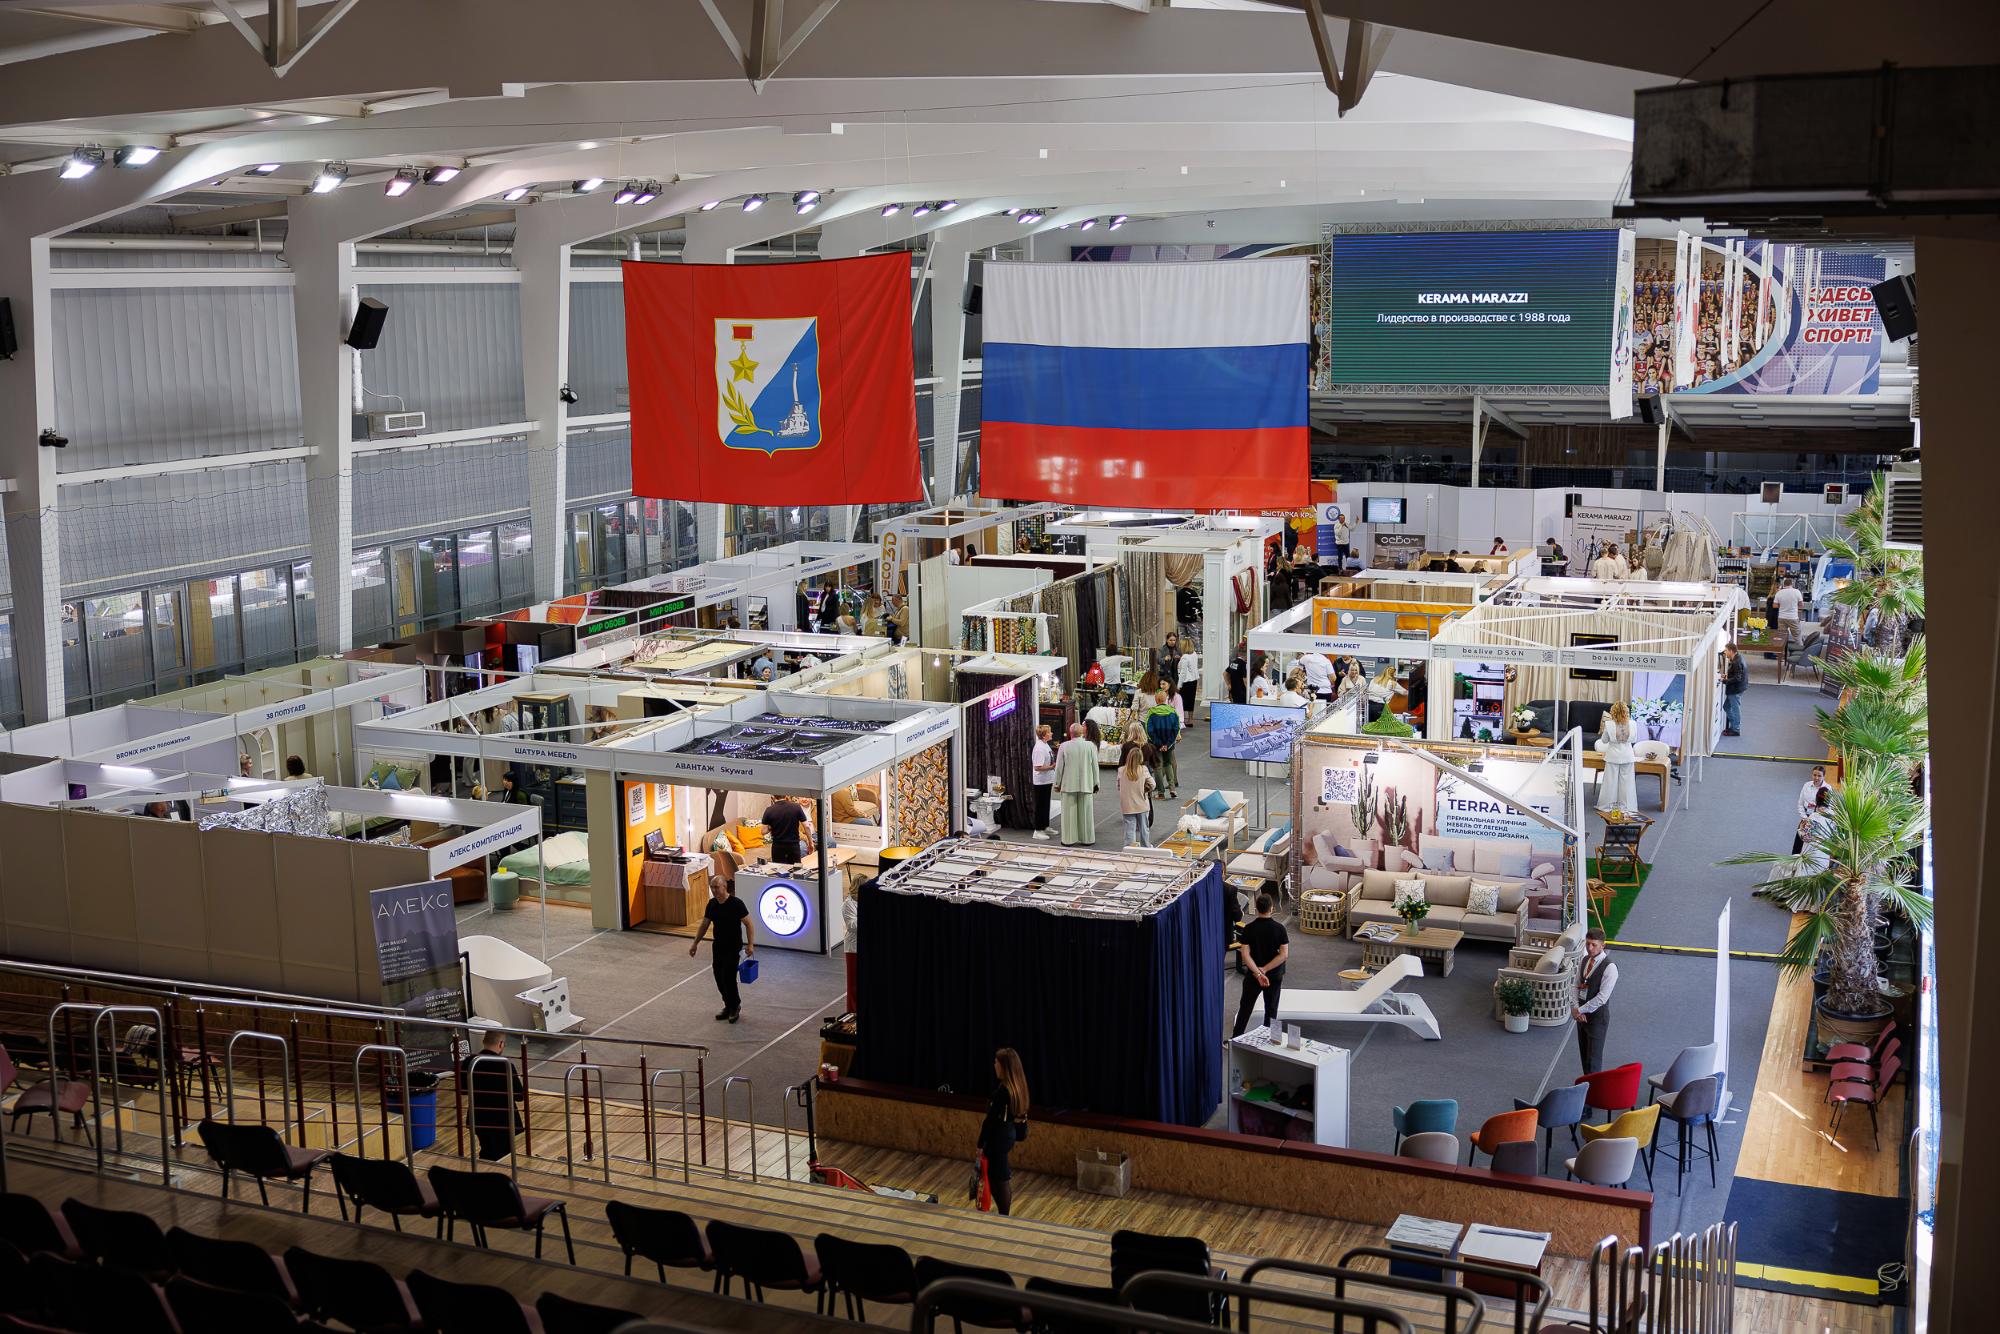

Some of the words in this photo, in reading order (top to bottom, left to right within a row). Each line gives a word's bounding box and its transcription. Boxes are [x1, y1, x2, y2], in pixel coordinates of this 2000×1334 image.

[1418, 293, 1470, 304] KERAMA
[1472, 292, 1528, 304] MARAZZI
[1809, 287, 1872, 304] ЗДЕСЬ
[1376, 313, 1428, 324] Лидерство
[1440, 314, 1508, 324] производстве
[1519, 313, 1545, 322] 1988
[1548, 314, 1571, 322] года
[1808, 308, 1874, 322] ЖИВЕТ
[1804, 328, 1872, 342] СПОРТ!
[650, 605, 664, 616] МИР
[664, 600, 685, 614] ОБОЕВ
[588, 623, 604, 634] МИР
[604, 617, 626, 630] ОБОЕВ
[274, 704, 306, 718] ПОПУГАЕВ
[906, 729, 926, 742] ПОТОЛКИ
[926, 718, 950, 734] ОСВЕЩЕНИЕ
[514, 748, 546, 757] ШАТУРА
[547, 751, 578, 760] МЕБЕЛЬ
[675, 762, 715, 772] АВАНТАЖ
[720, 766, 753, 776] Skyward
[1448, 798, 1502, 814] TERRA
[1446, 815, 1495, 824] ПРЕМИАЛЬНАЯ
[1496, 818, 1527, 826] УЛИЧНАЯ
[1446, 828, 1496, 837] ИТАЛЬЯНСКОГО
[1497, 832, 1530, 840] ДИЗАЙНА
[449, 844, 470, 859] АЛЕКС
[471, 824, 522, 851] КОМПЛЕКТАЦИЯ
[377, 893, 449, 918] АЛЕКС
